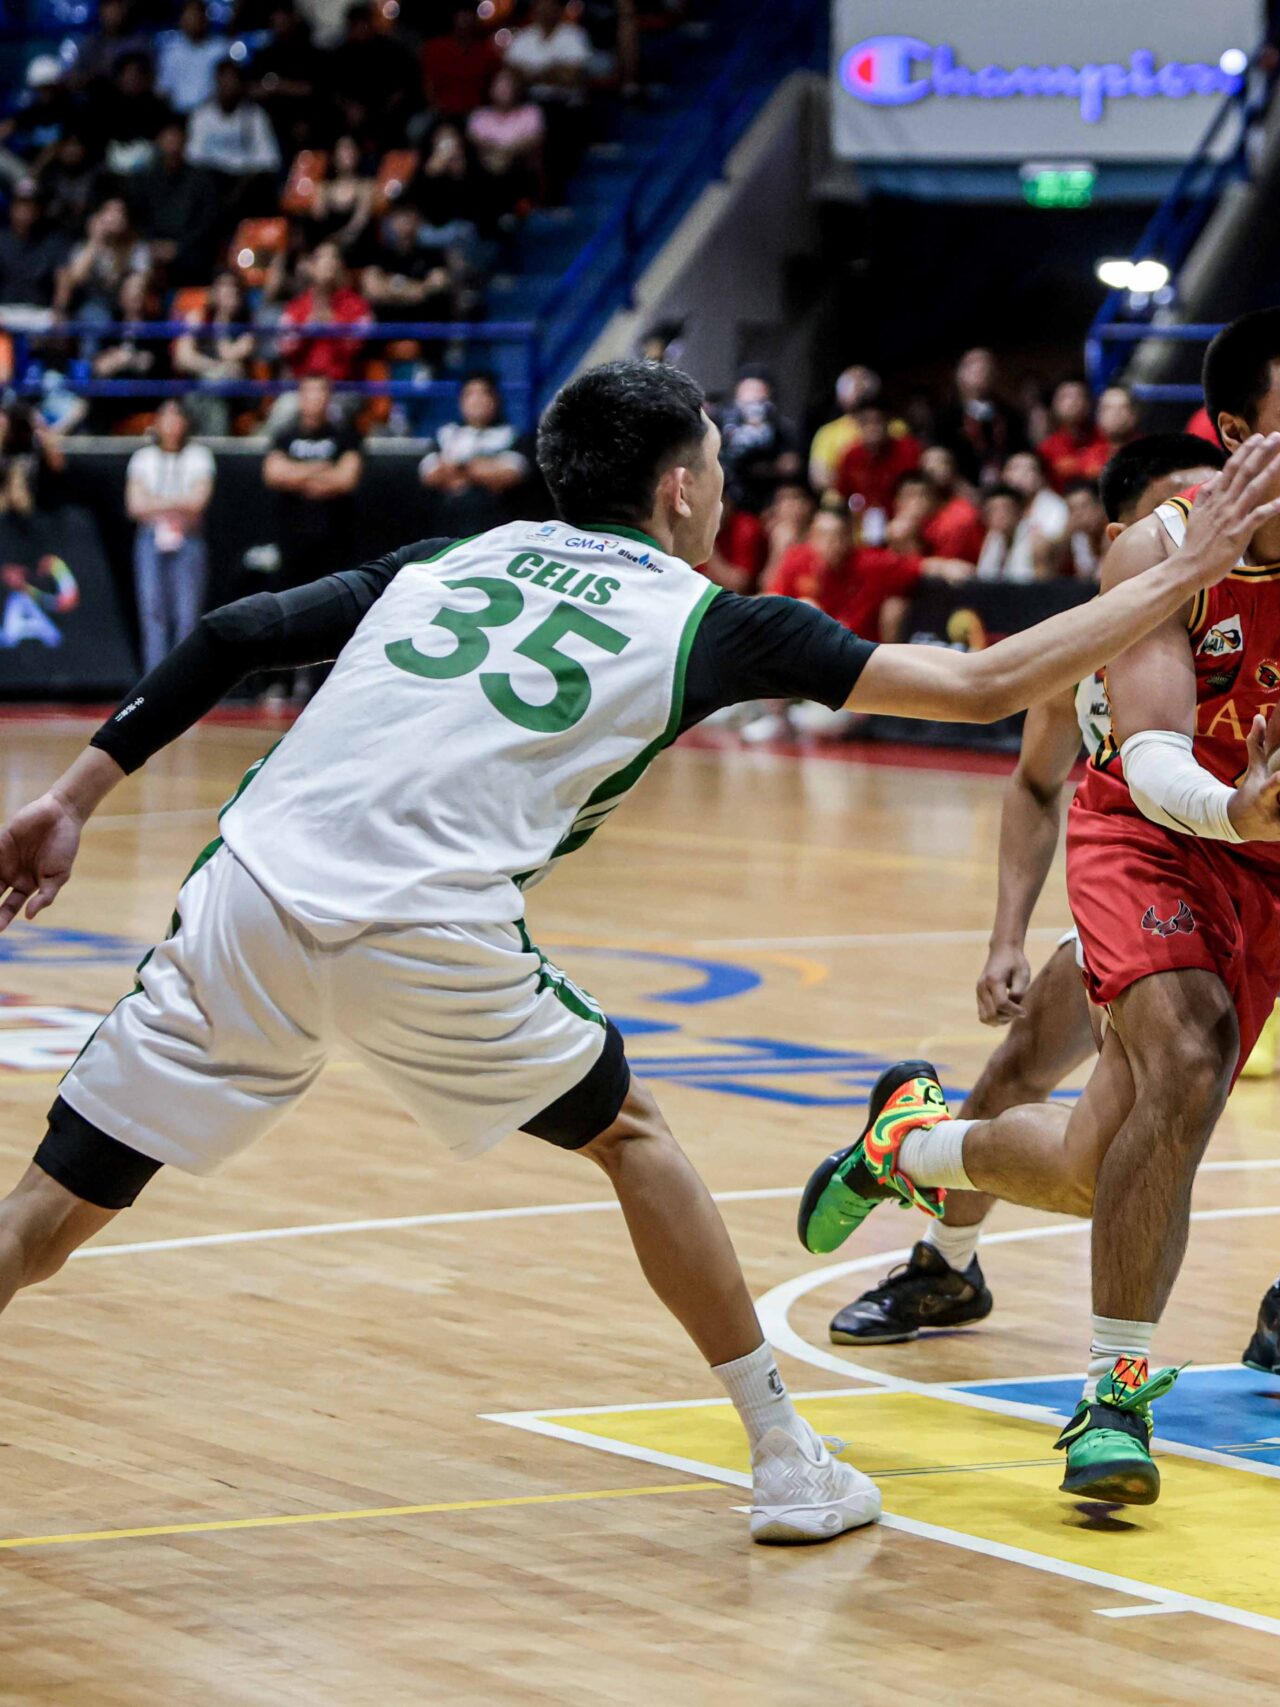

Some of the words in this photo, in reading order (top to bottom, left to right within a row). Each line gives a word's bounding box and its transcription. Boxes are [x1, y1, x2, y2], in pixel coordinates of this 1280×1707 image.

[565, 537, 606, 552] GMA
[617, 549, 639, 563] Blue
[506, 552, 621, 605] CELIS
[384, 576, 632, 733] 35
